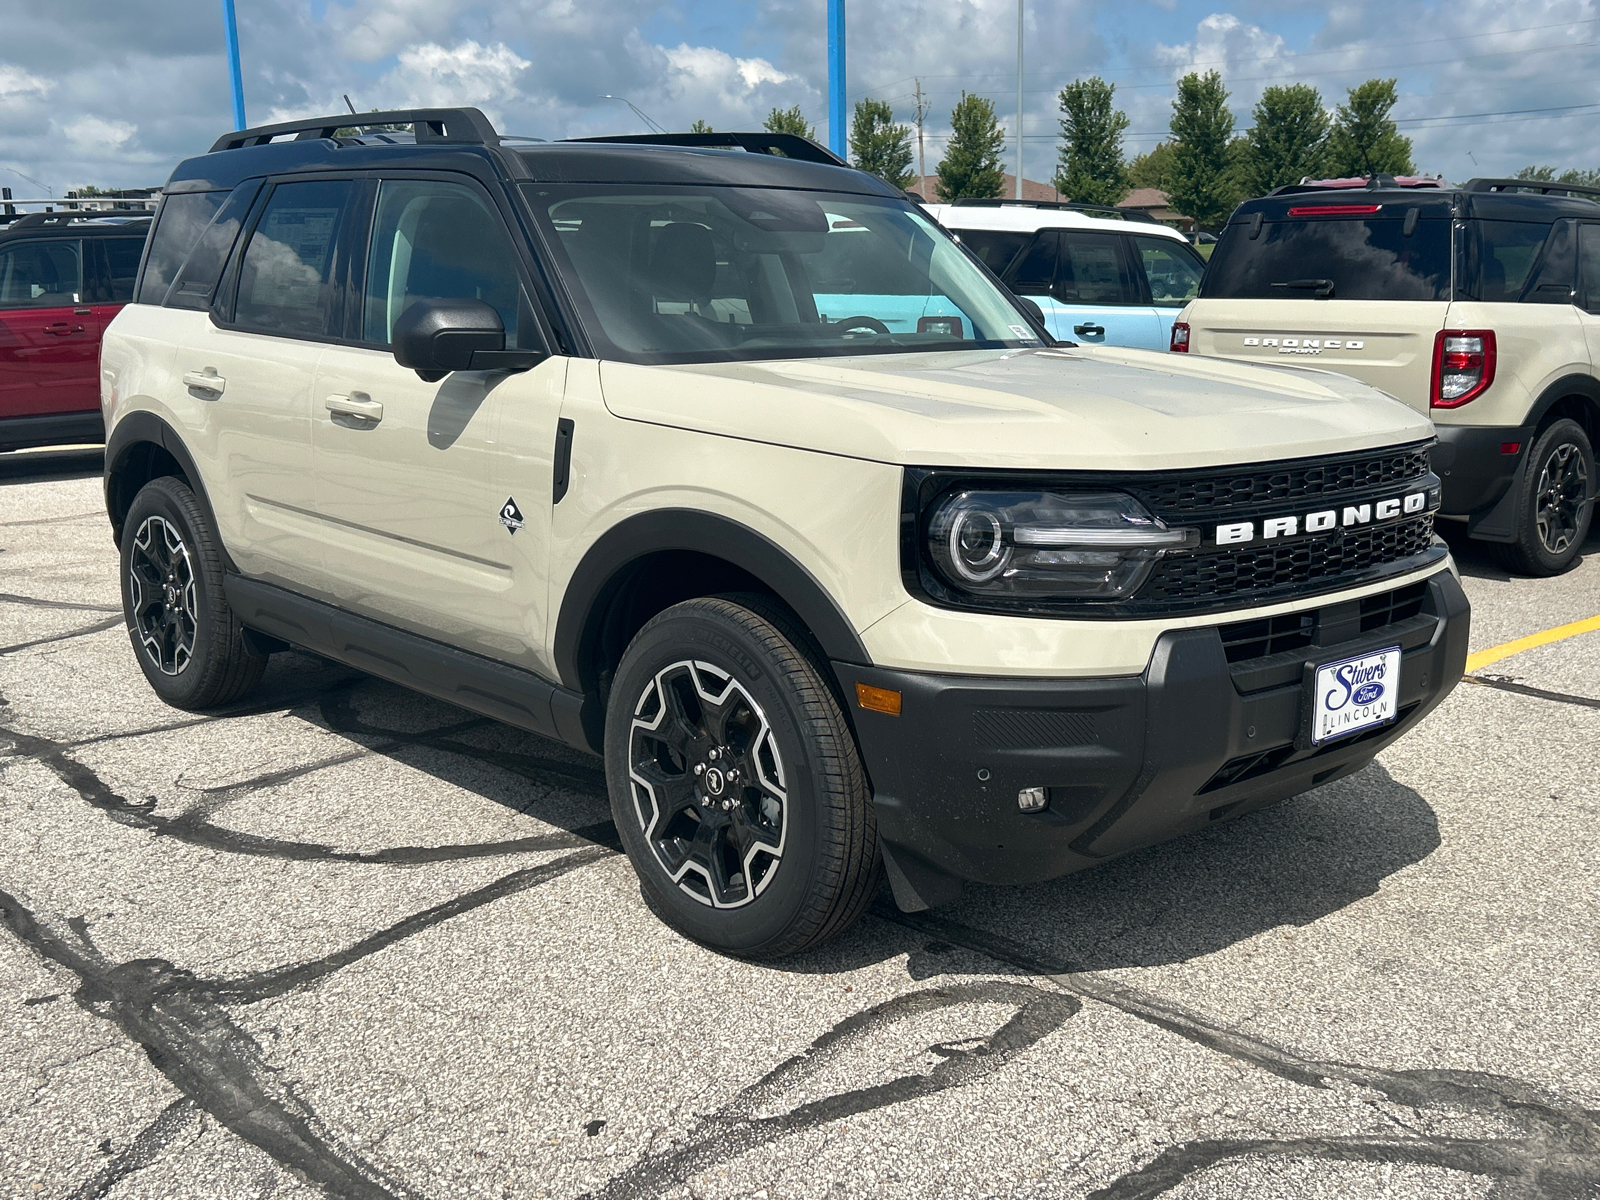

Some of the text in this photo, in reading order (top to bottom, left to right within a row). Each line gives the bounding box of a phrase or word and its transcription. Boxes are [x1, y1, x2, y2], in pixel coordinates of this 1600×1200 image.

[1243, 337, 1364, 350] BRONCO
[1216, 493, 1425, 545] BRONCO
[697, 628, 760, 677] MICHELIN
[1325, 661, 1387, 711] Stivers
[1358, 685, 1379, 702] Ford
[1330, 701, 1387, 728] LINCOLN
